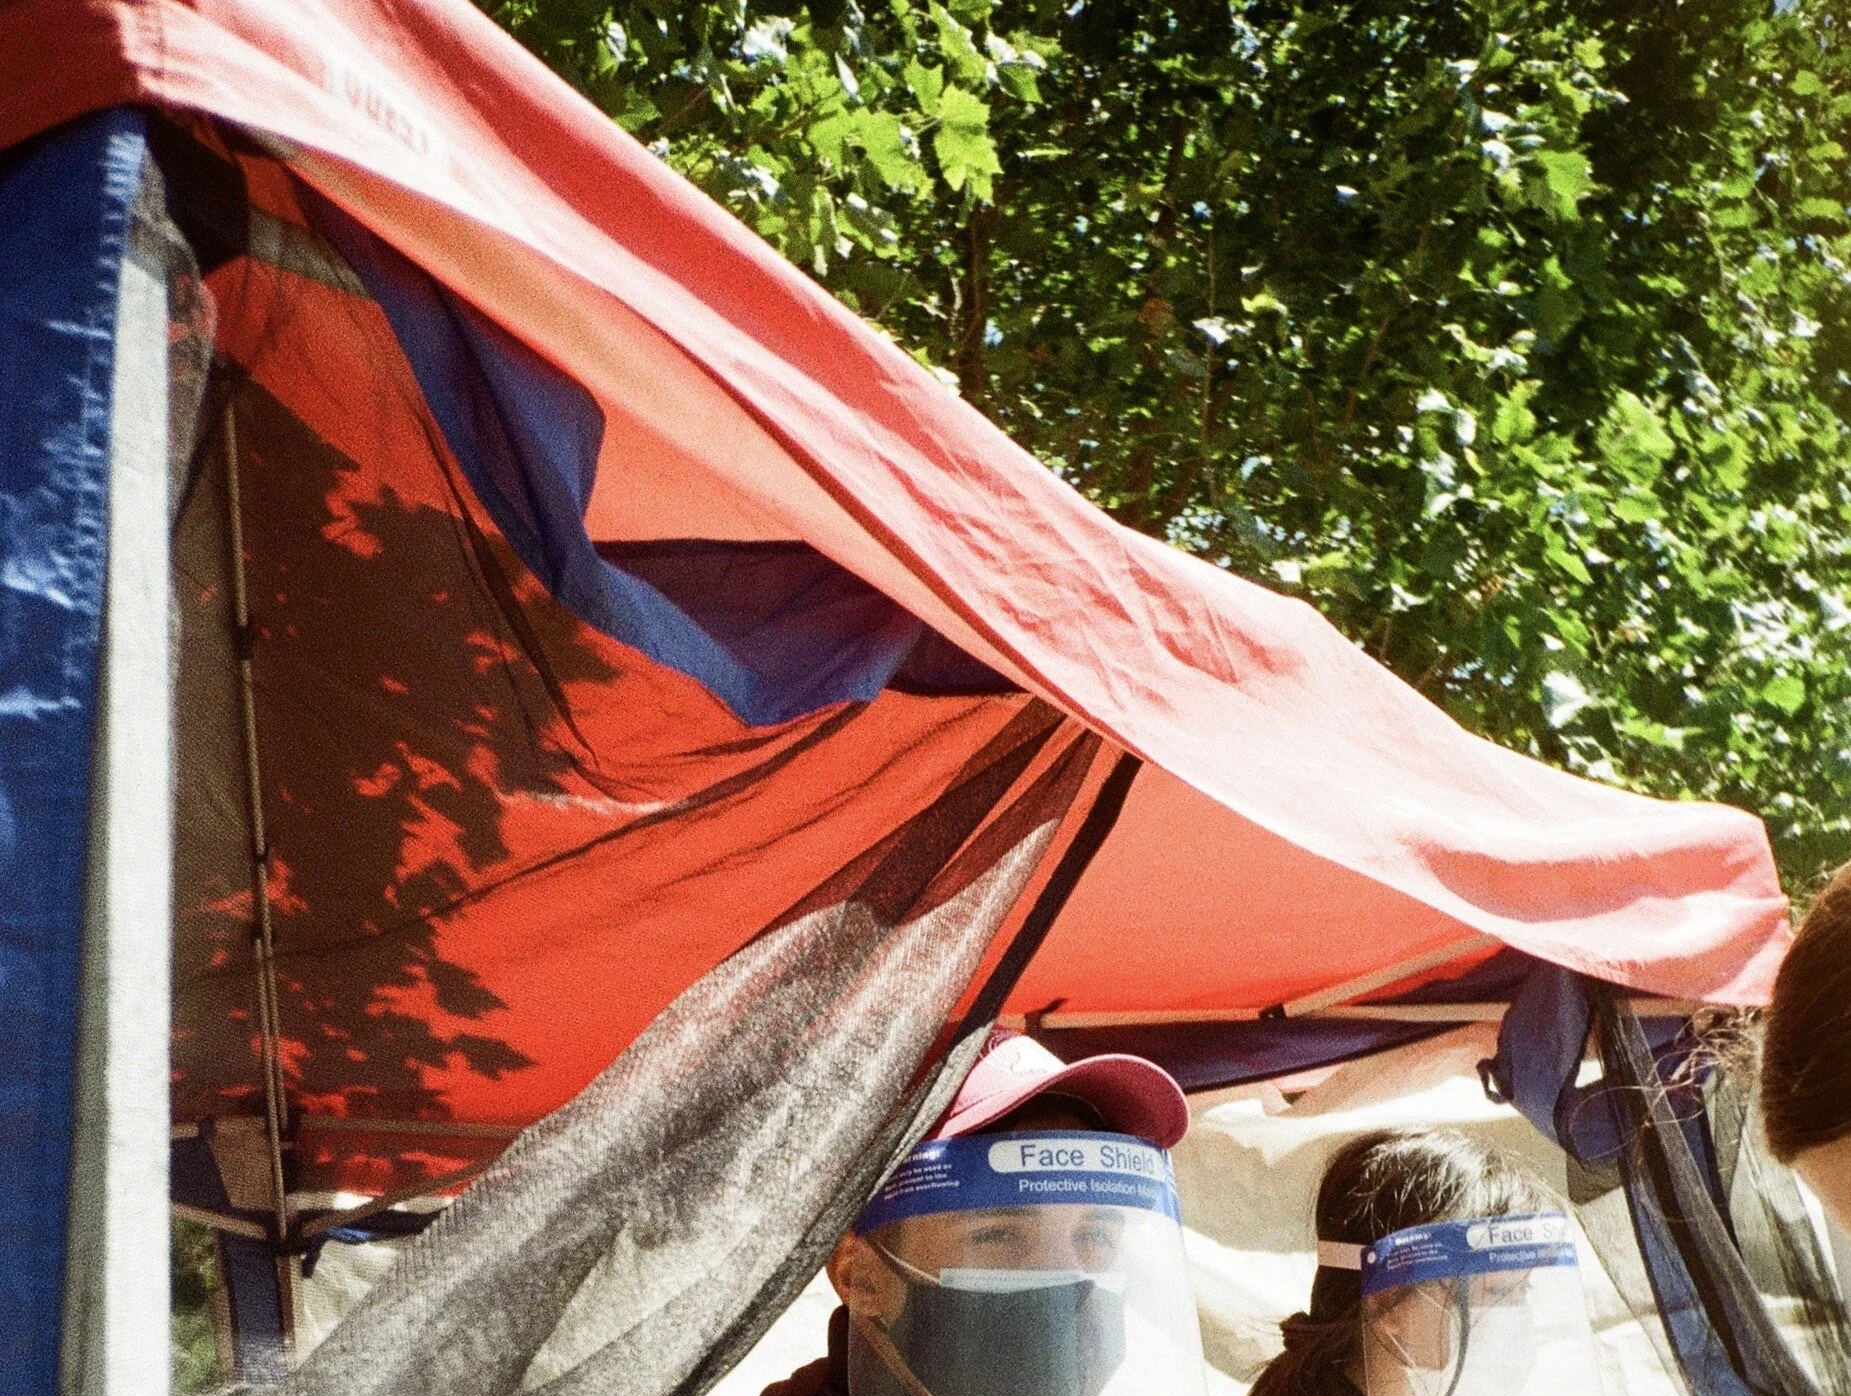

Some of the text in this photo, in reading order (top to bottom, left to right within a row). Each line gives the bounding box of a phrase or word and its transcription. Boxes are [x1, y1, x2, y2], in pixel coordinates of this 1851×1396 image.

[1020, 1144, 1155, 1174] Face Shield
[1018, 1179, 1087, 1193] Protective
[1091, 1179, 1136, 1194] Isolation
[1488, 1225, 1532, 1243] Face
